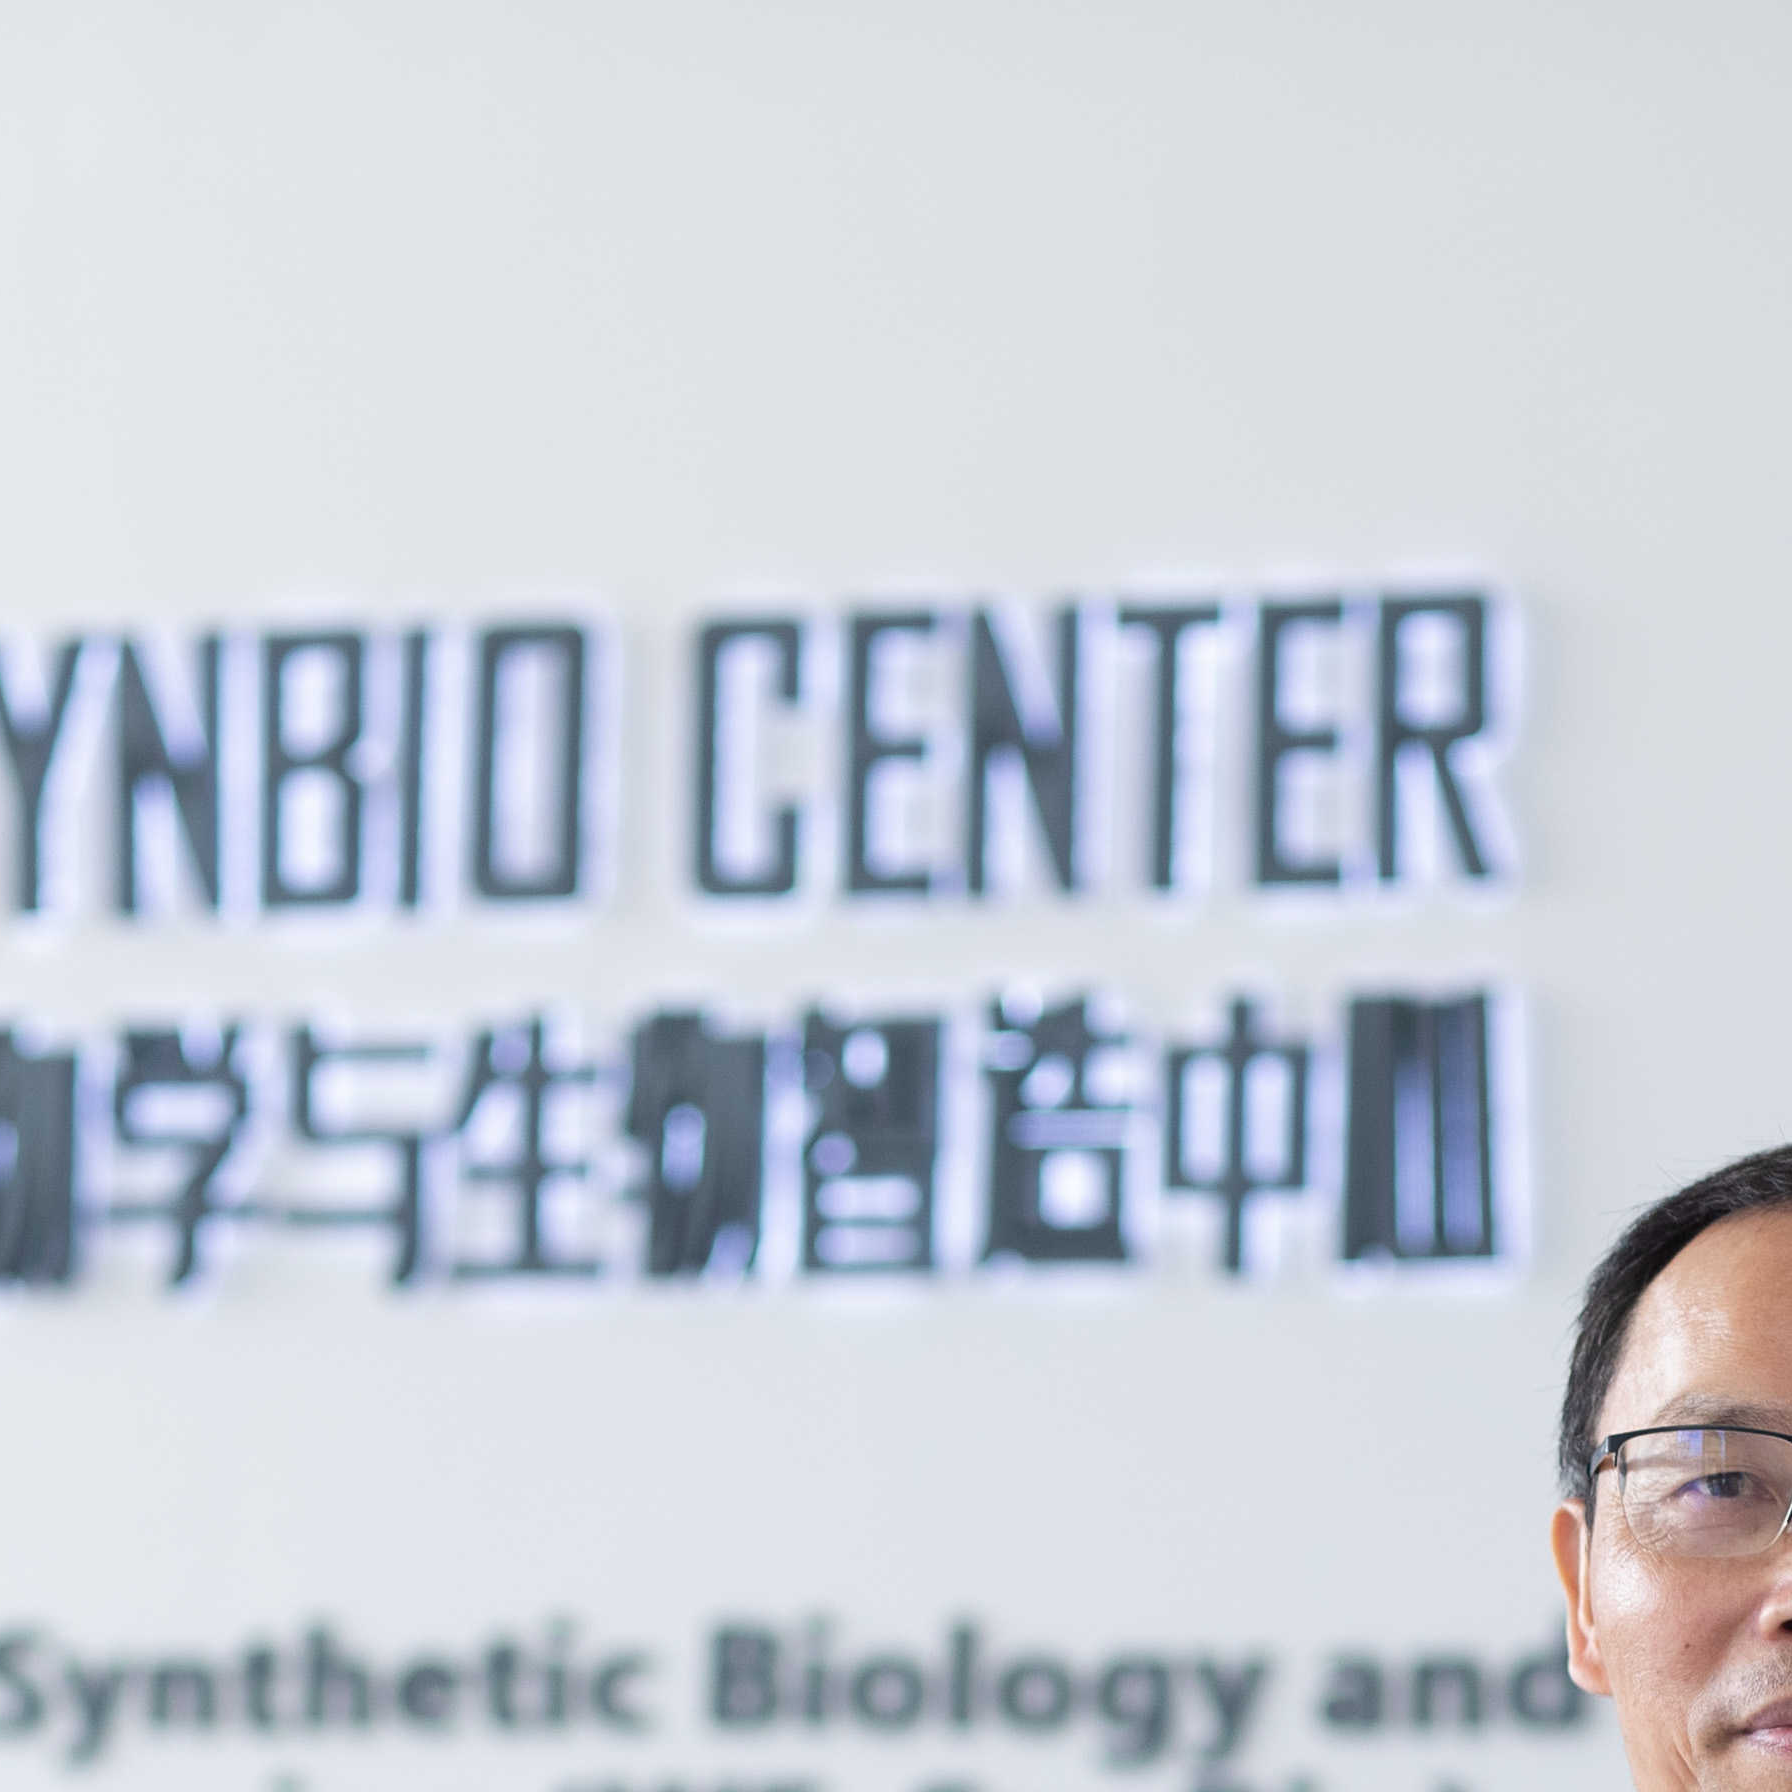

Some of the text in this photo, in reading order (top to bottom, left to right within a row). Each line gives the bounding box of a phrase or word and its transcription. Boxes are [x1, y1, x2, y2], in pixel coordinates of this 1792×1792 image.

[692, 593, 1495, 896] CENTER
[709, 1624, 1275, 1768] Biology
[1319, 1618, 1587, 1732] and
